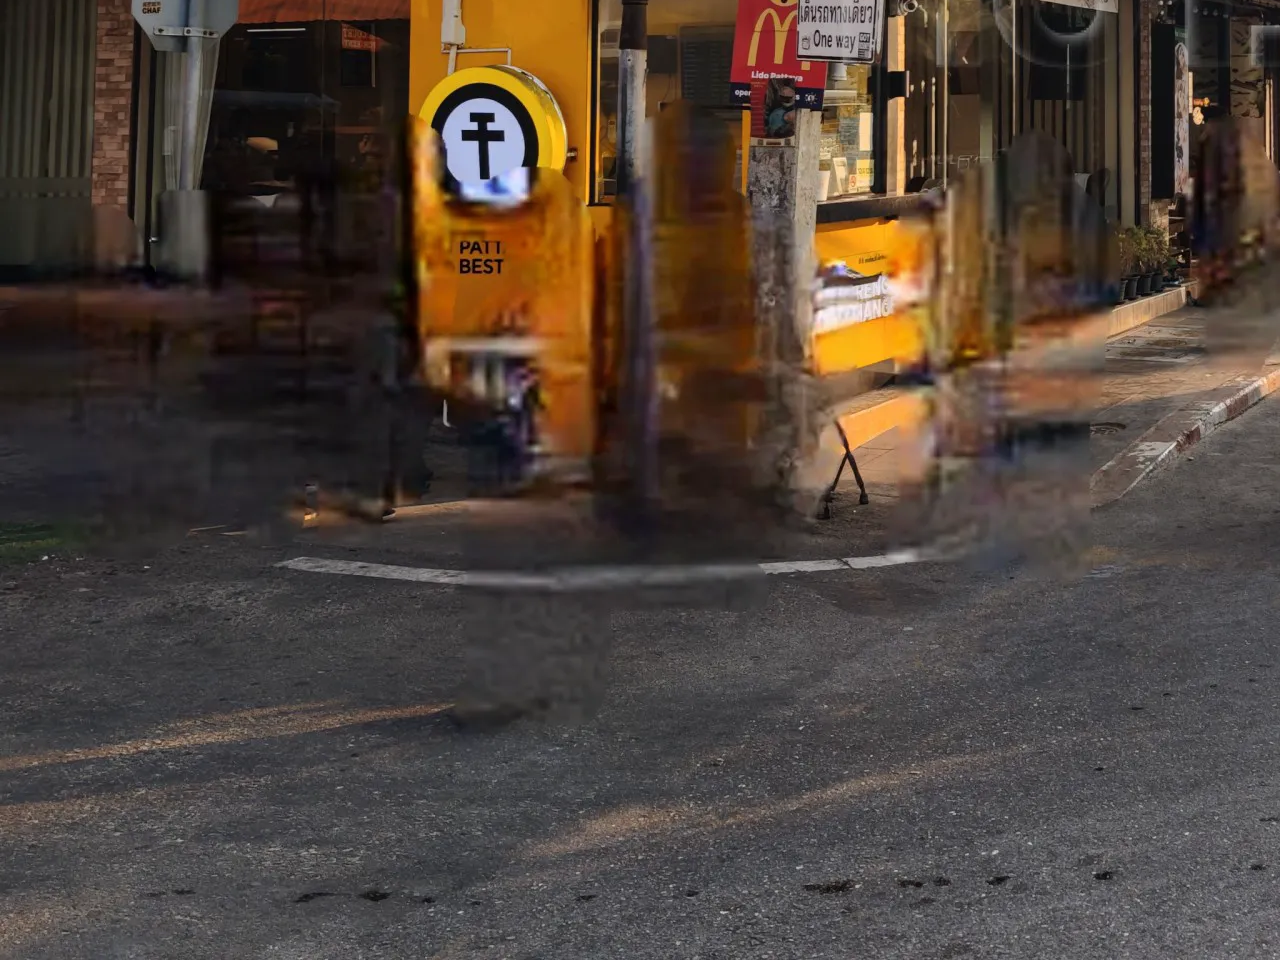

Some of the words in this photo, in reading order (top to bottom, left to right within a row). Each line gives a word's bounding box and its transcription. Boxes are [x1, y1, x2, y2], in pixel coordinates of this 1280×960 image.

[799, 0, 873, 24] เดินรถทางเดียว
[813, 29, 833, 48] One
[835, 33, 856, 53] way
[751, 71, 769, 80] Lido
[459, 258, 504, 274] BEST
